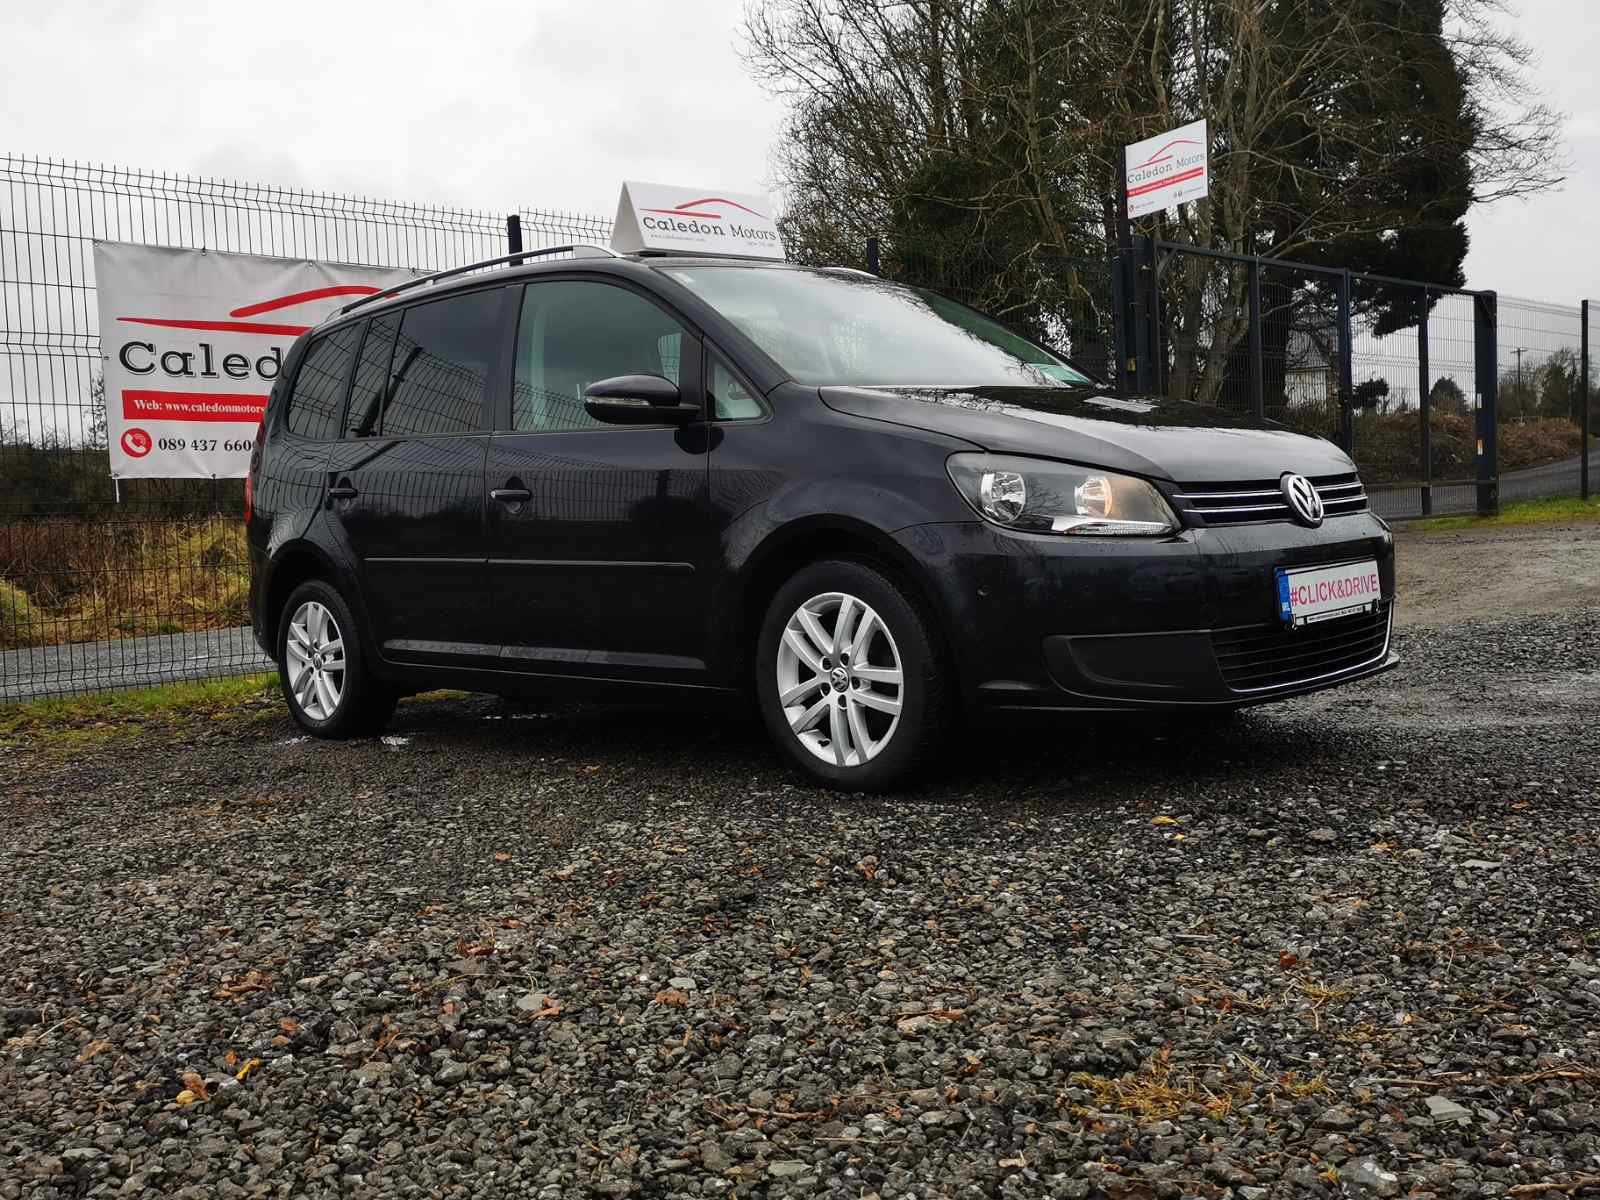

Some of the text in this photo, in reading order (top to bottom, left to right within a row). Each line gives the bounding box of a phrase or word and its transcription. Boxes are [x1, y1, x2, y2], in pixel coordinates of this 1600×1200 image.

[643, 217, 777, 241] Caledon Motors
[119, 341, 283, 381] Caled
[133, 399, 163, 411] Web:
[158, 438, 186, 451] 089
[191, 439, 218, 451] 437
[1290, 574, 1378, 605] #CLICK&DRIVE
